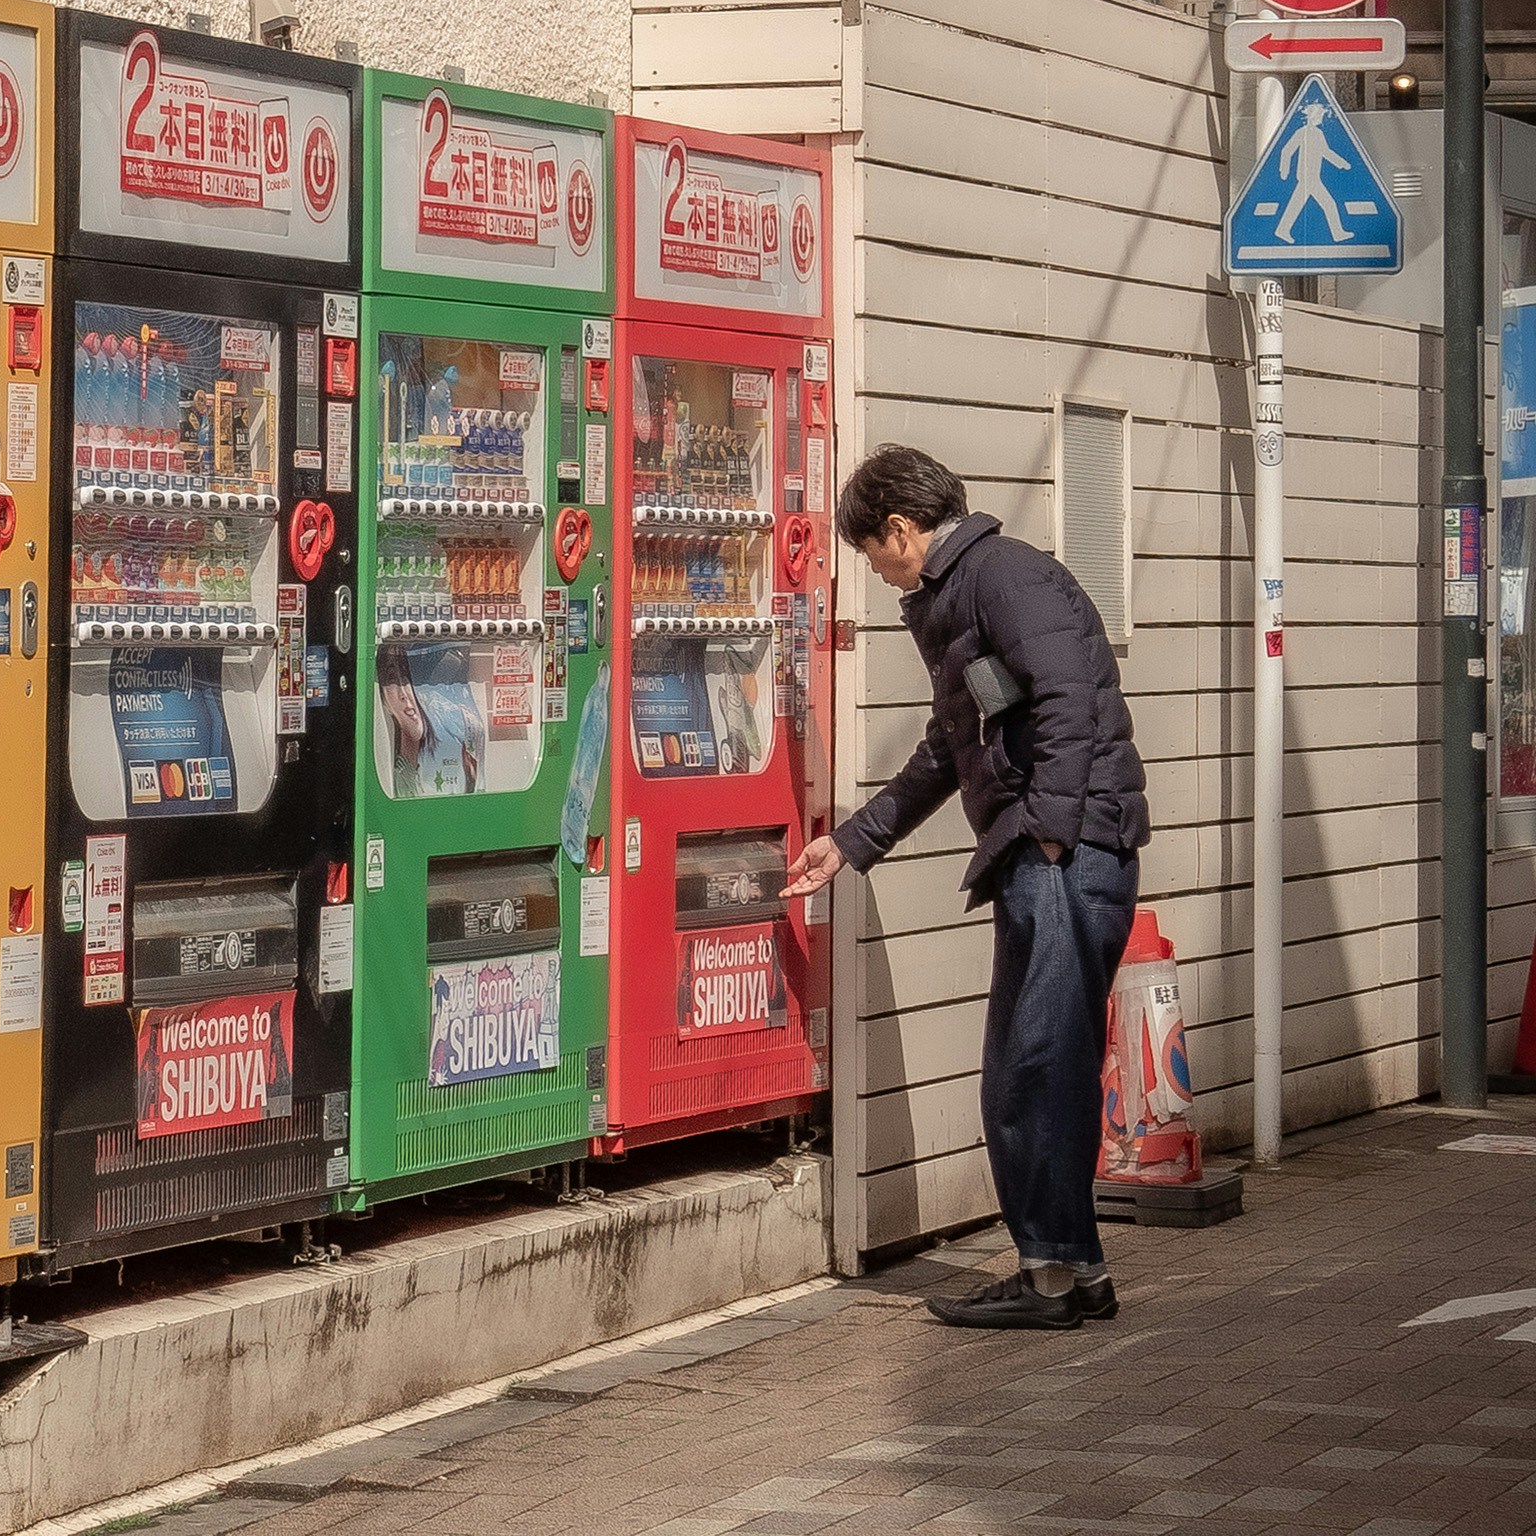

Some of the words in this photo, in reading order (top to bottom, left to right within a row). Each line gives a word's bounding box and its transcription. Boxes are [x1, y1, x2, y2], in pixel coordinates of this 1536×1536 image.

[117, 648, 154, 664] ACCEPT
[115, 670, 178, 688] CONTACTLESS
[116, 694, 164, 712] PAYMENTS
[134, 770, 156, 790] VISA
[189, 771, 211, 788] JCB
[694, 937, 756, 971] Welcome
[758, 933, 773, 965] to
[449, 975, 524, 1013] Welcome
[524, 971, 544, 997] to
[693, 970, 770, 1029] SHIBUYA
[162, 1011, 249, 1053] Welcome
[251, 1005, 272, 1041] to
[449, 1009, 539, 1075] SHIBUYA
[161, 1049, 268, 1122] SHIBUYA
